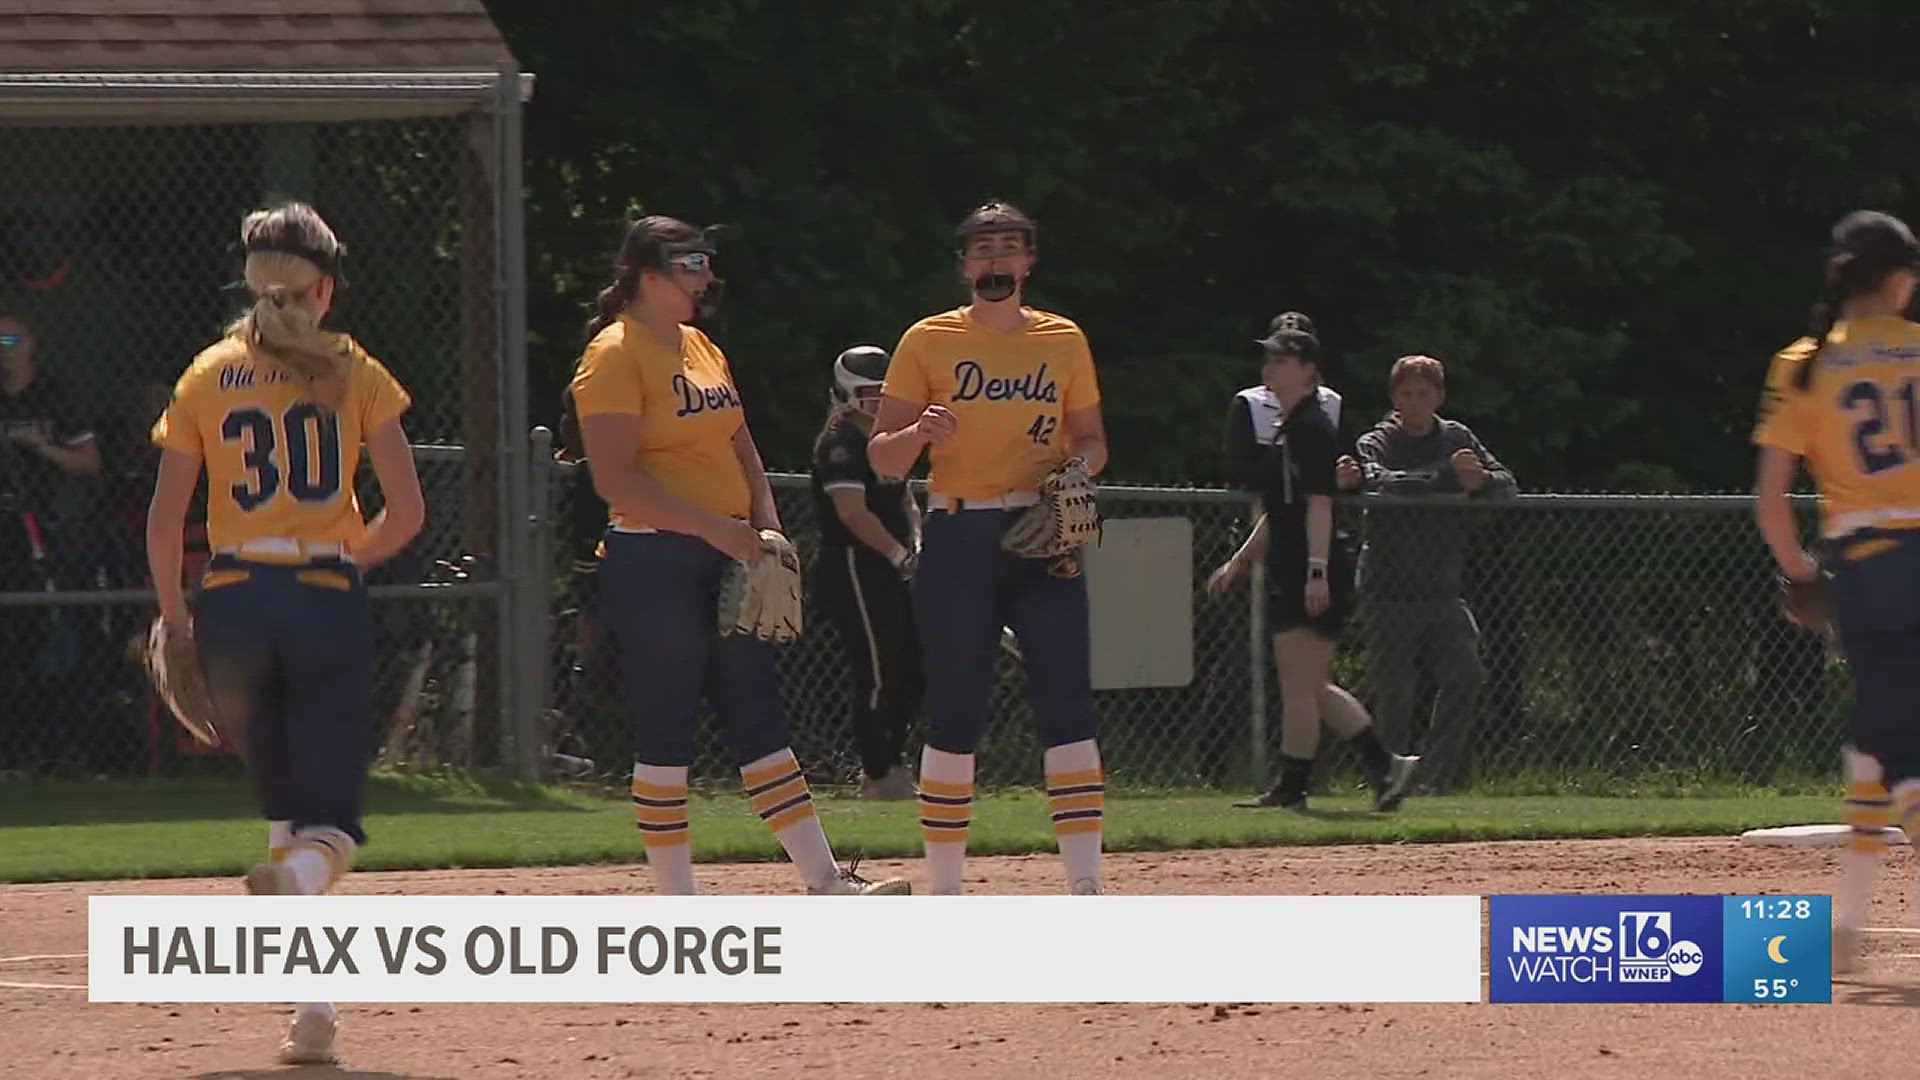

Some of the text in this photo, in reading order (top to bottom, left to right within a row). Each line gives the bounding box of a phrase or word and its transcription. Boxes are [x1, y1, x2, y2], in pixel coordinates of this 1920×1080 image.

[952, 361, 1057, 402] Devils
[1027, 414, 1056, 445] 42
[220, 401, 342, 512] 30
